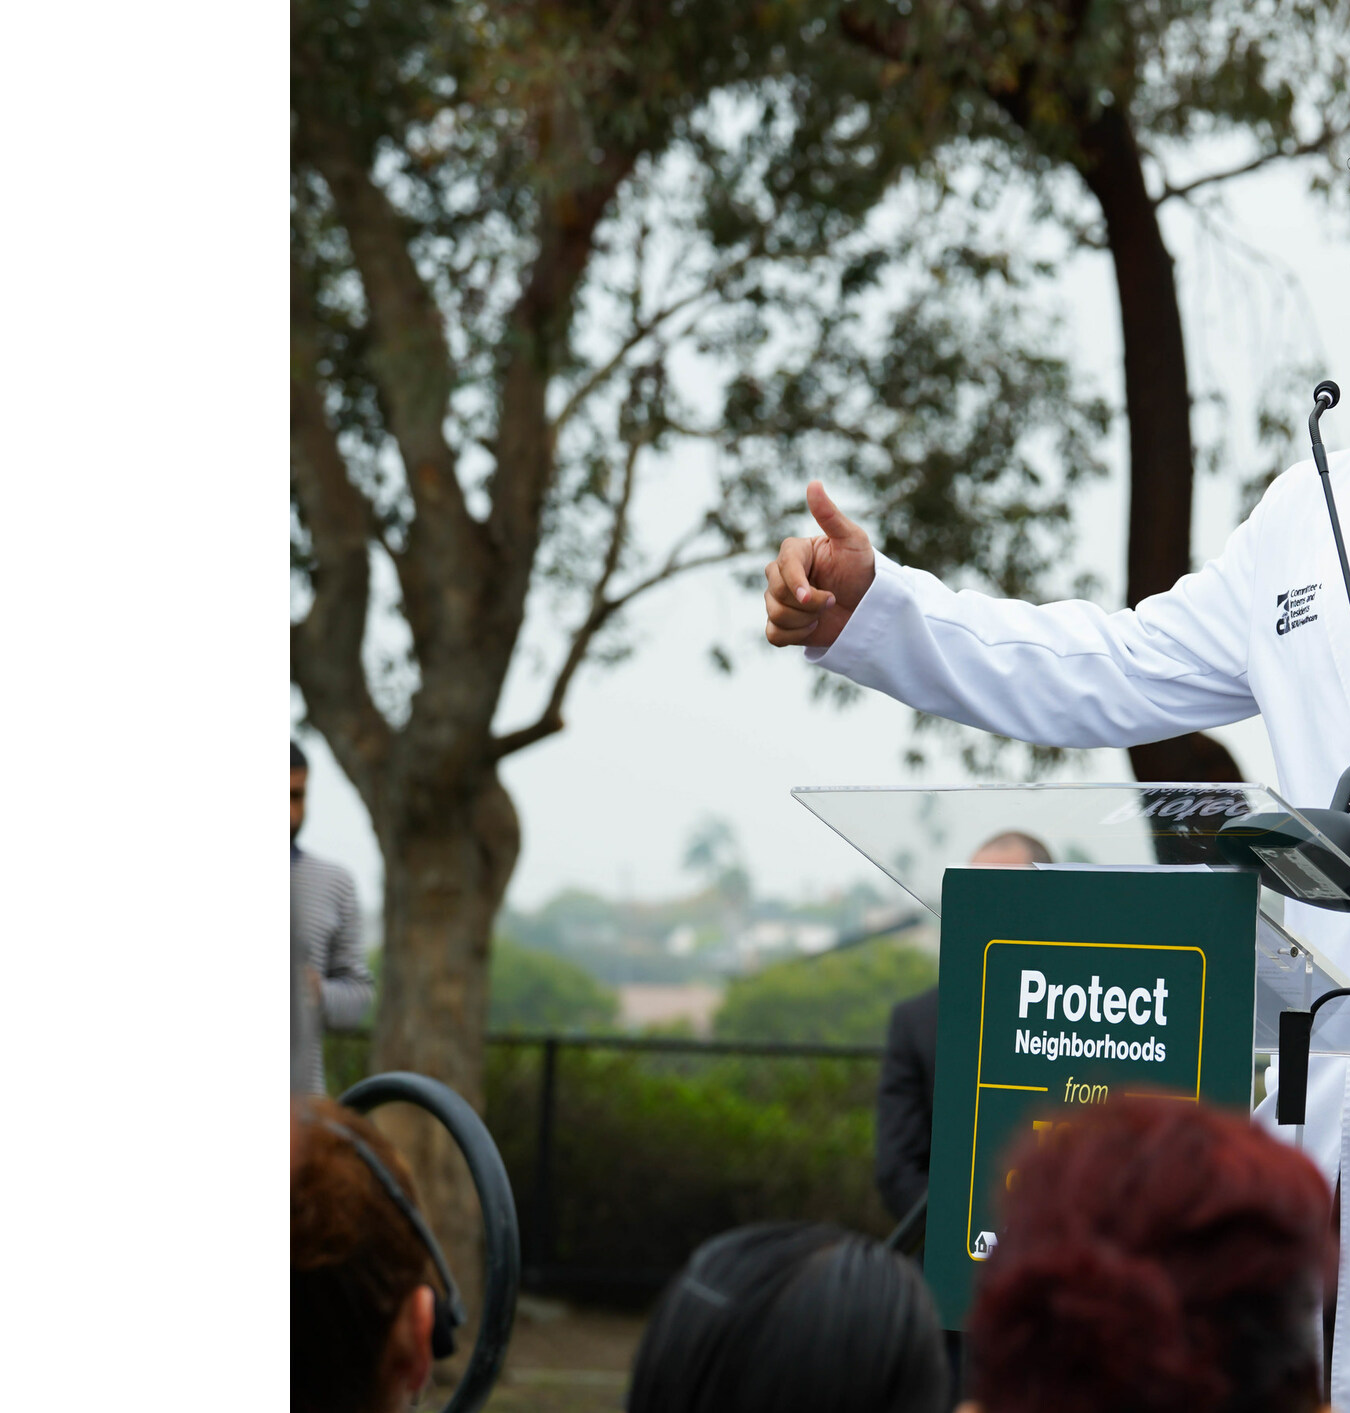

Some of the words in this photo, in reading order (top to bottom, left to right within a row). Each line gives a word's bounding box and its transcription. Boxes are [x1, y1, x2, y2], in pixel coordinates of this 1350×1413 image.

[1018, 969, 1169, 1026] Protect
[1014, 1029, 1166, 1063] Neighborhoods
[1063, 1076, 1109, 1105] from
